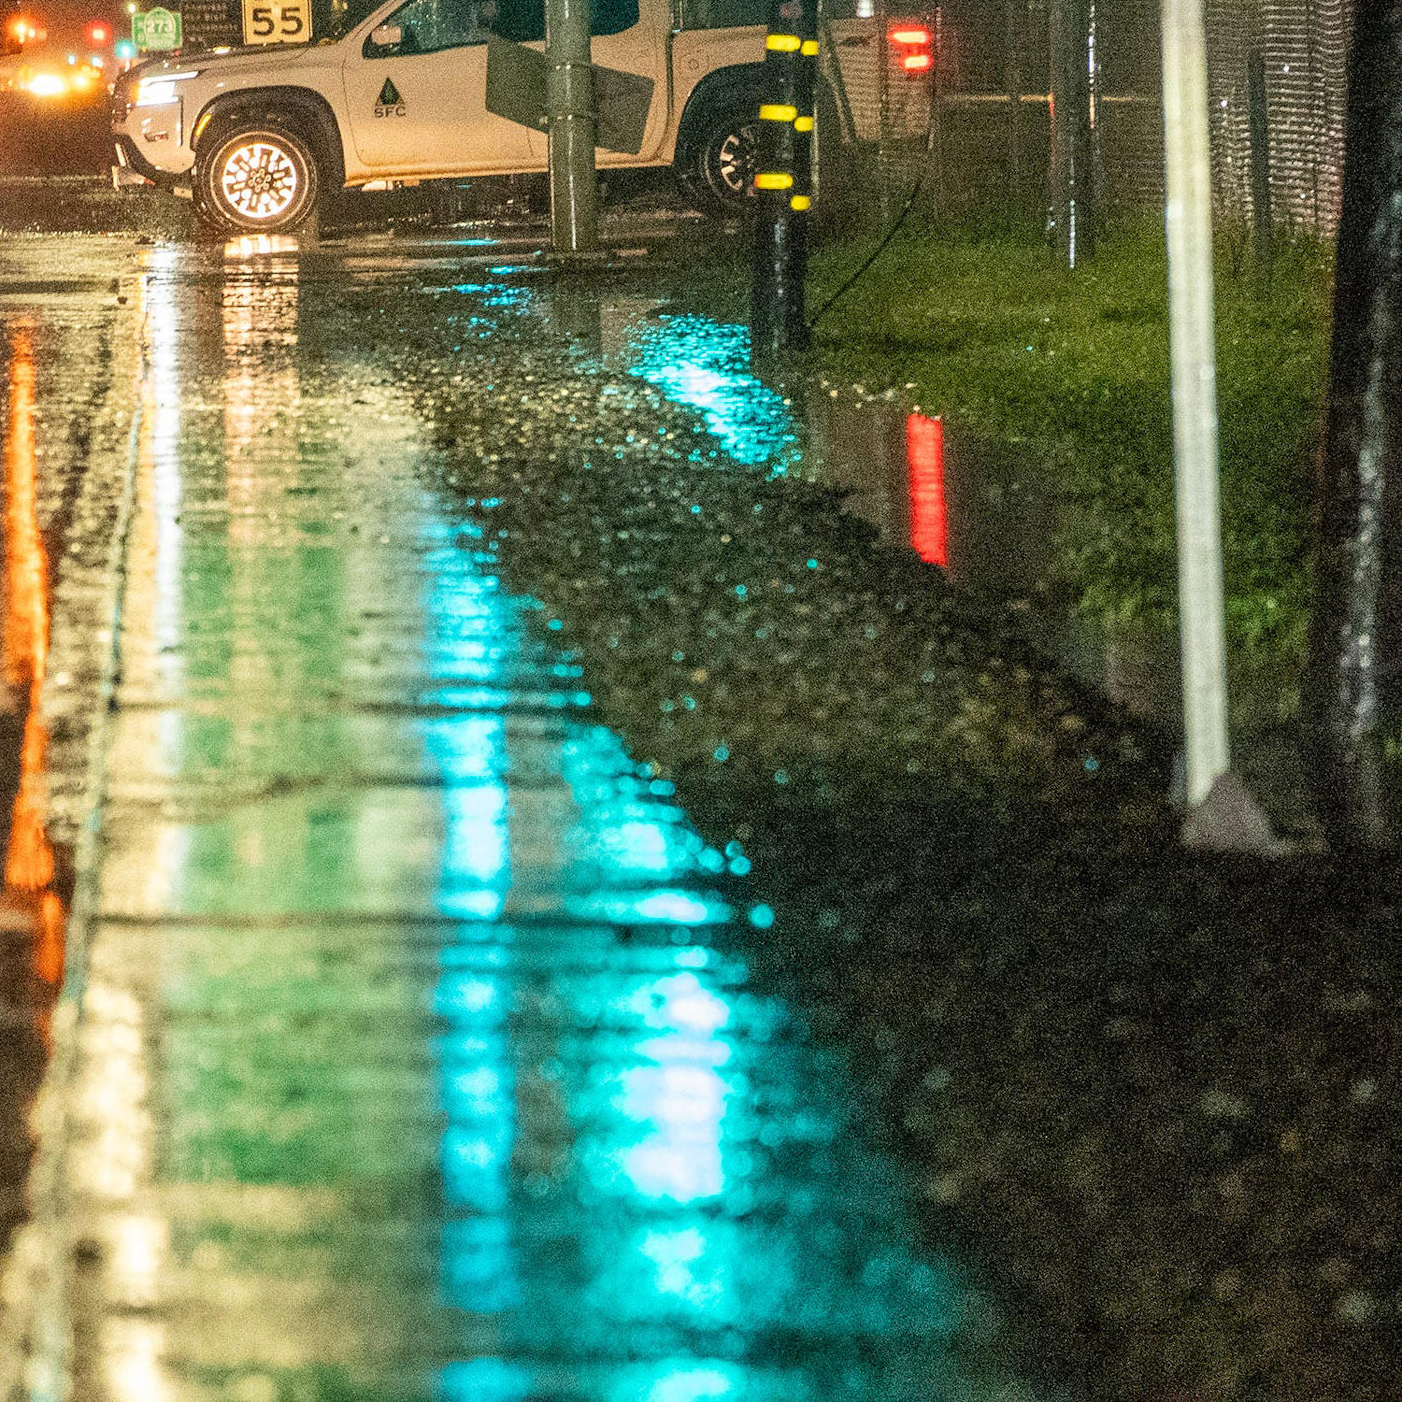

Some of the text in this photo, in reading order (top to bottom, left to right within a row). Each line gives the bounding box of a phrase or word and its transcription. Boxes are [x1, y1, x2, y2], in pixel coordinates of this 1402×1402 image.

[146, 19, 173, 33] 273
[252, 7, 303, 37] 55
[374, 105, 407, 118] SFC
